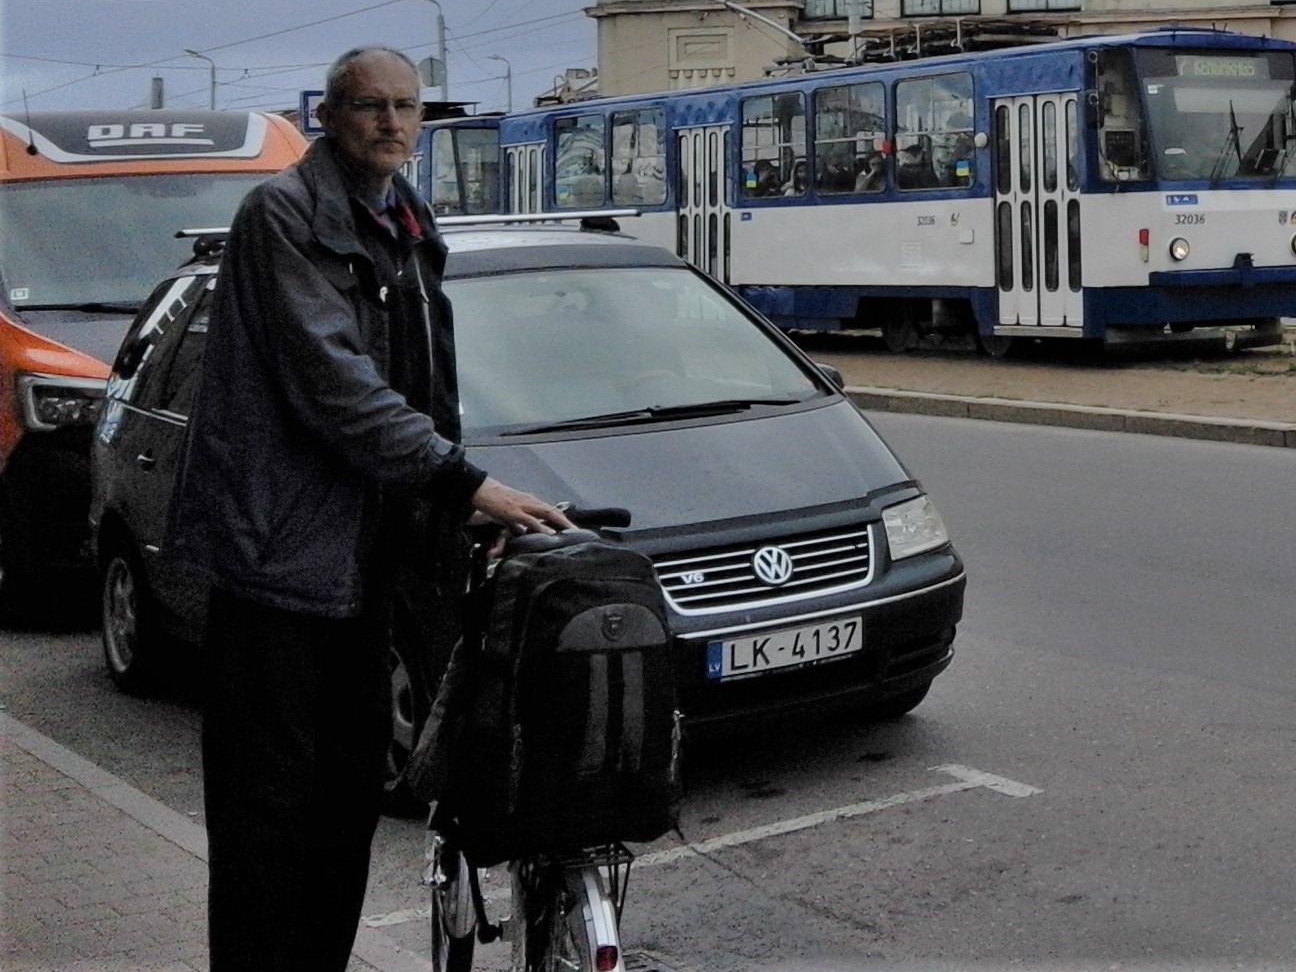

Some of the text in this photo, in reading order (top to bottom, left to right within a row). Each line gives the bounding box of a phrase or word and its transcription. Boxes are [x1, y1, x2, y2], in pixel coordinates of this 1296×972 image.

[87, 123, 204, 140] DAF
[1174, 214, 1206, 225] 32036
[681, 572, 704, 584] V6
[730, 621, 858, 671] LK-4137
[708, 663, 721, 673] LV
